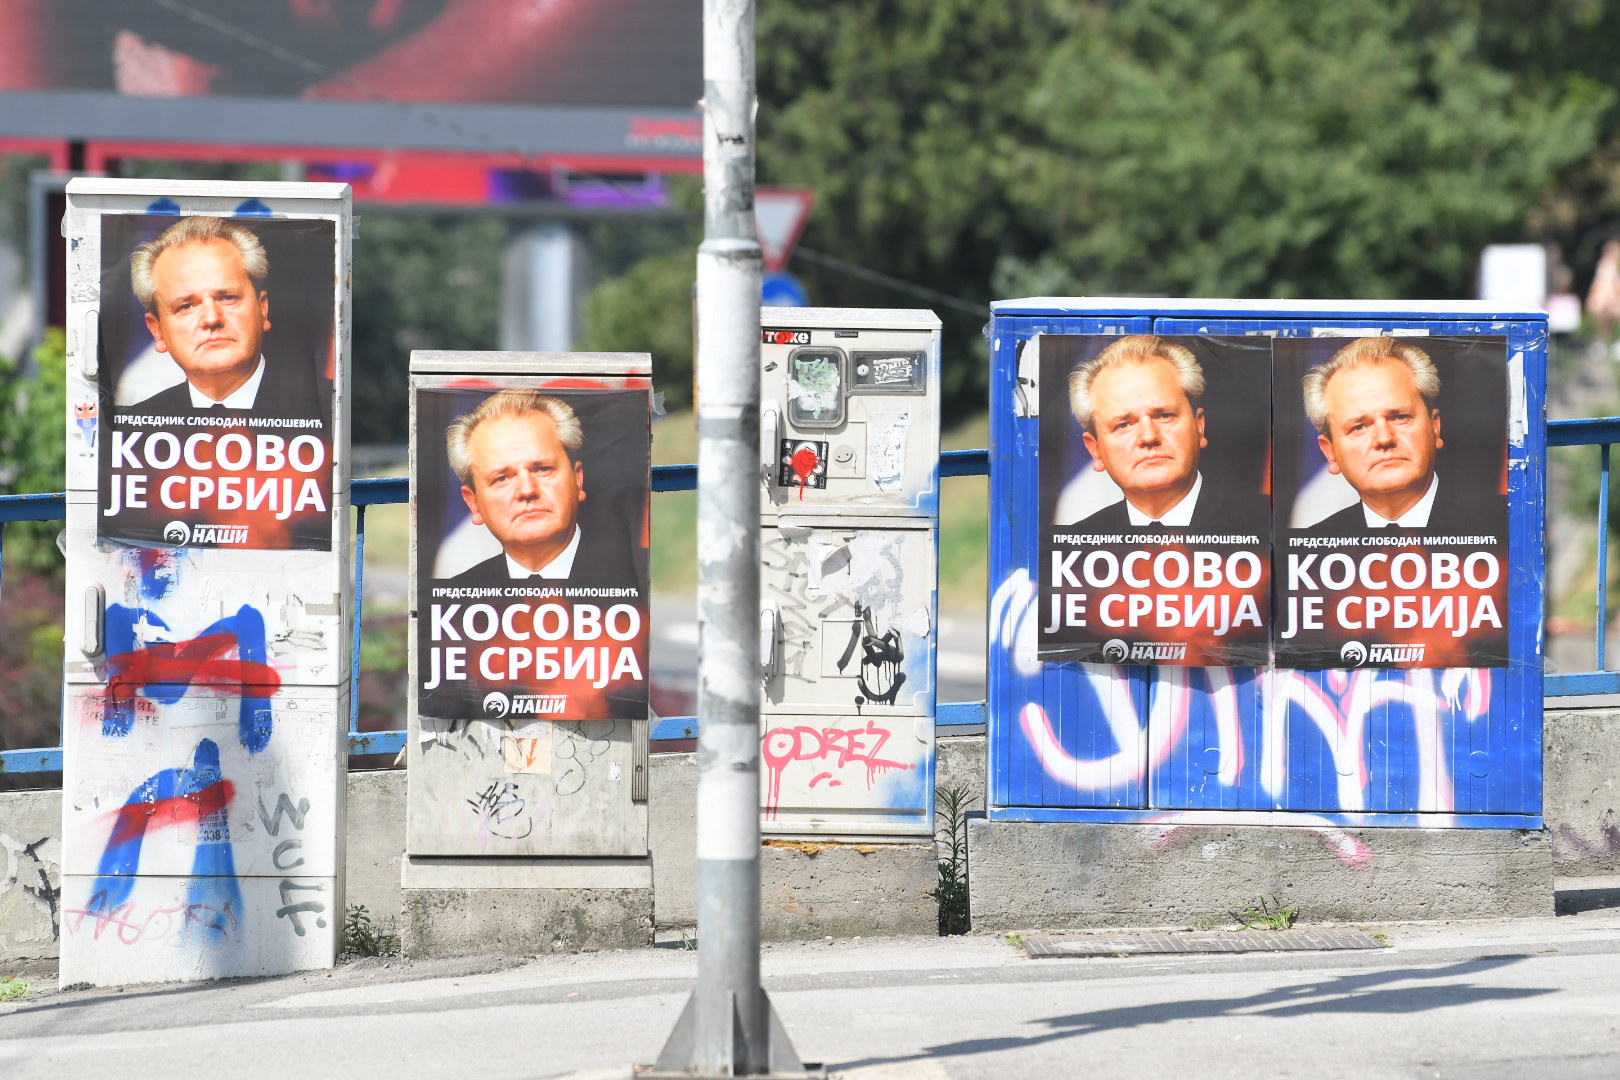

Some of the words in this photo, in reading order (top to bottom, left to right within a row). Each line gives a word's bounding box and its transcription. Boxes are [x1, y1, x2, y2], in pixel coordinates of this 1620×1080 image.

[114, 415, 185, 426] ПРЕДСЕДНИК
[187, 417, 246, 428] СЛОБОДАН
[249, 418, 322, 428] МИЛОШЕВИЋ
[112, 431, 324, 472] КОСОВО
[104, 475, 148, 516] ЈЕ
[160, 476, 327, 520] СРБИЈА
[192, 529, 248, 543] НАШИ
[1054, 535, 1123, 545] ПРЕДСЕДНИК
[1125, 535, 1183, 545] СЛОБОДАН
[1186, 535, 1259, 544] МИЛОШЕВИЋ
[1290, 537, 1359, 548] ПРЕДСЕДНИК
[1362, 537, 1420, 547] СЛОБОДАН
[1424, 536, 1497, 545] МИЛОШЕВИЋ
[1052, 551, 1261, 588] КОСОВО
[1288, 552, 1499, 590] КОСОВО
[433, 588, 502, 598] ПРЕДСЕДНИК
[504, 588, 562, 598] СЛОБОДАН
[566, 588, 638, 597] МИЛОШЕВИЋ
[431, 604, 640, 641] КОСОВО
[1045, 594, 1087, 633] ЈЕ
[1100, 594, 1263, 636] СРБИЈА
[1282, 597, 1324, 638] ЈЕ
[1337, 595, 1503, 637] СРБИЈА
[1131, 647, 1186, 659] НАШИ
[1369, 648, 1424, 662] НАШИ
[424, 647, 467, 689] ЈЕ
[480, 647, 643, 689] СРБИЈА
[511, 699, 566, 713] НАШИ
